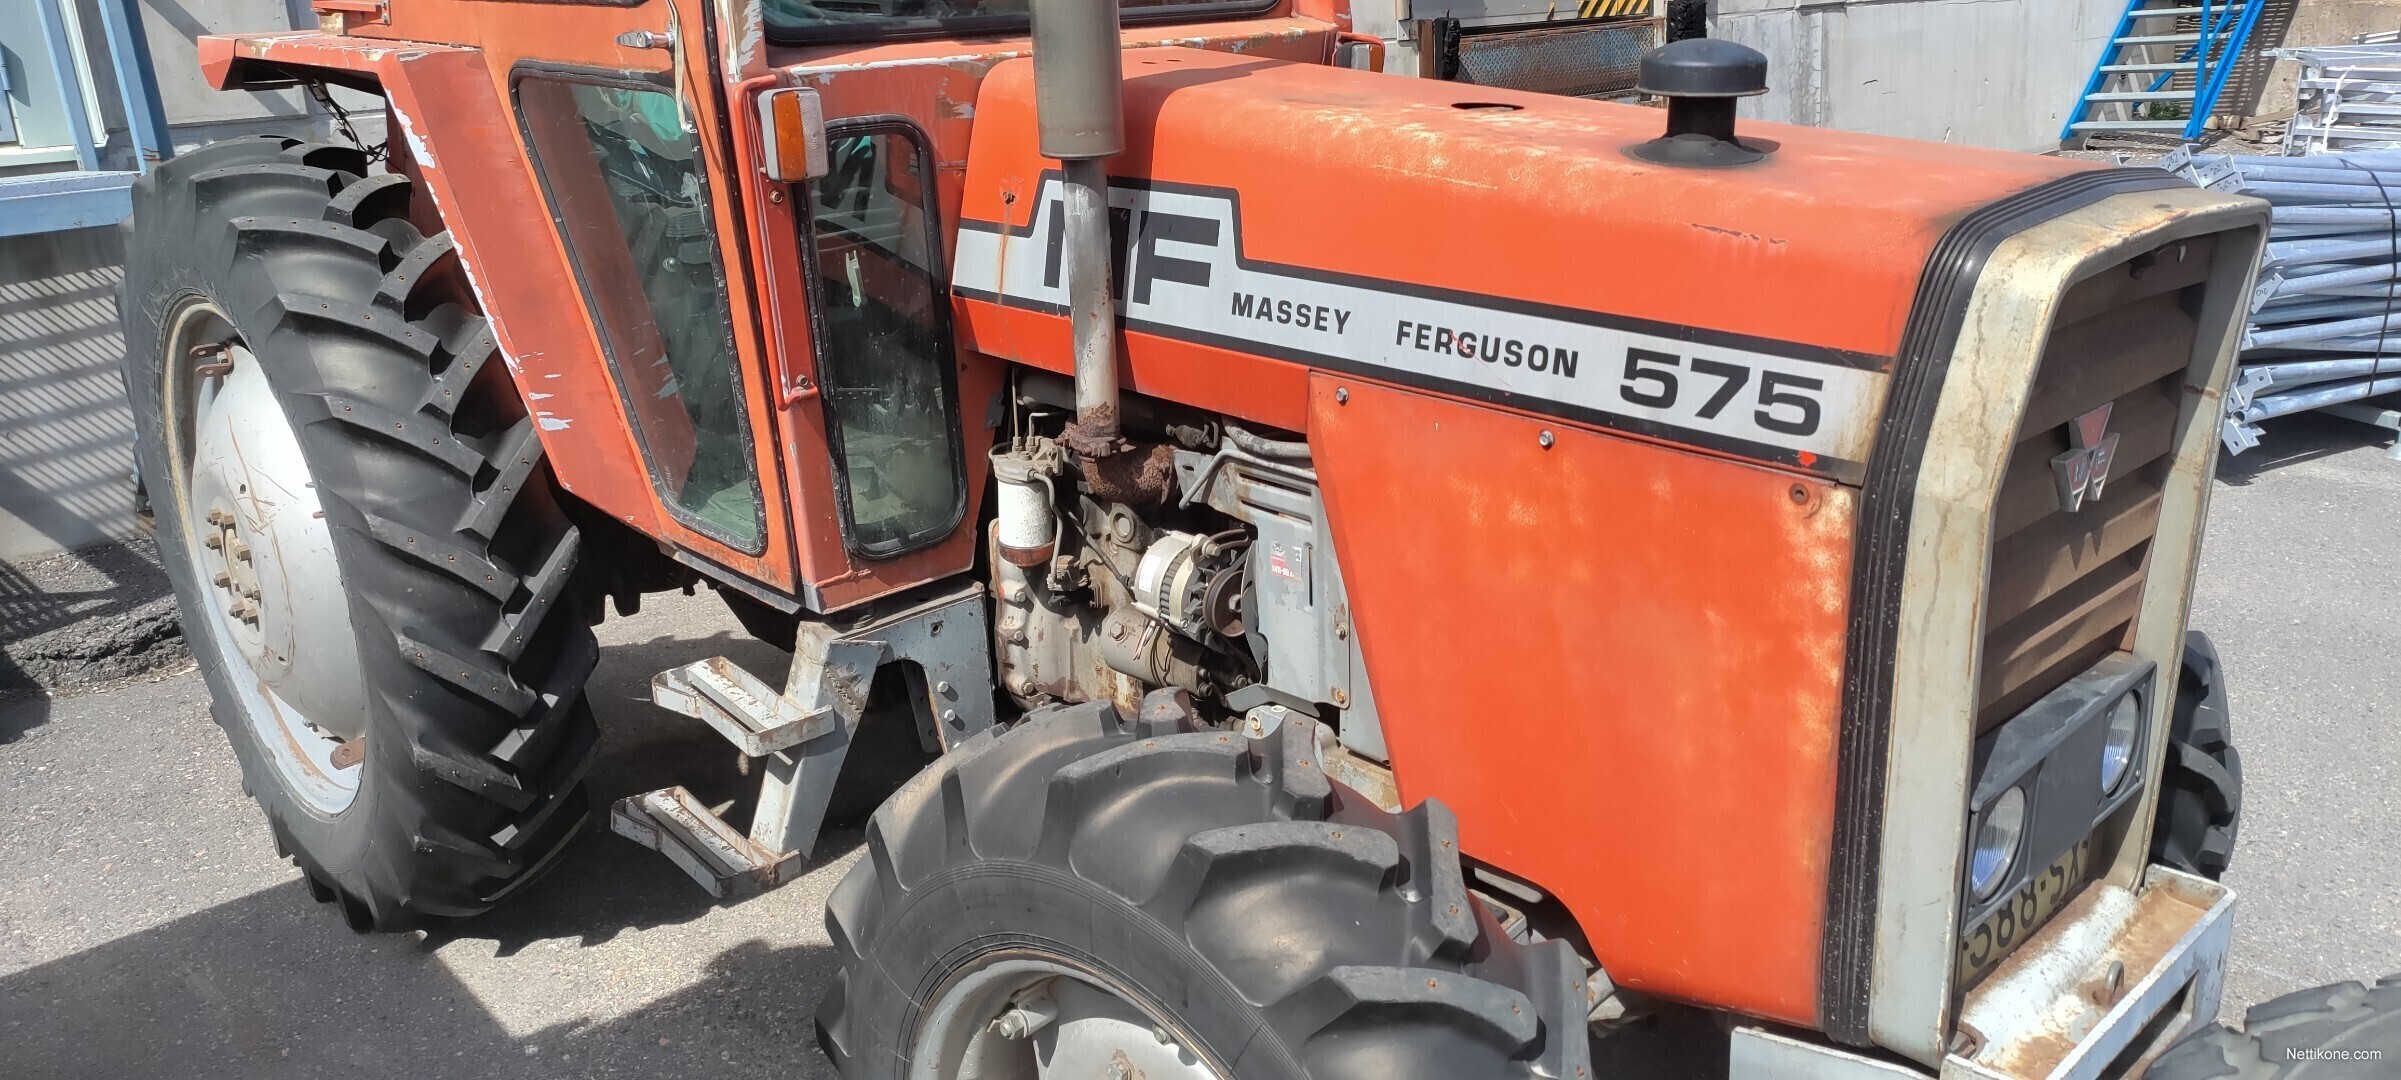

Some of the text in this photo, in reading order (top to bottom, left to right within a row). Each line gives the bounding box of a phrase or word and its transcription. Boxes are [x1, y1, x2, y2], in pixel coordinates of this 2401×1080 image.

[1230, 291, 1352, 336] MASSEY
[1395, 319, 1580, 379] FERGUSON
[1618, 345, 1825, 438] 575
